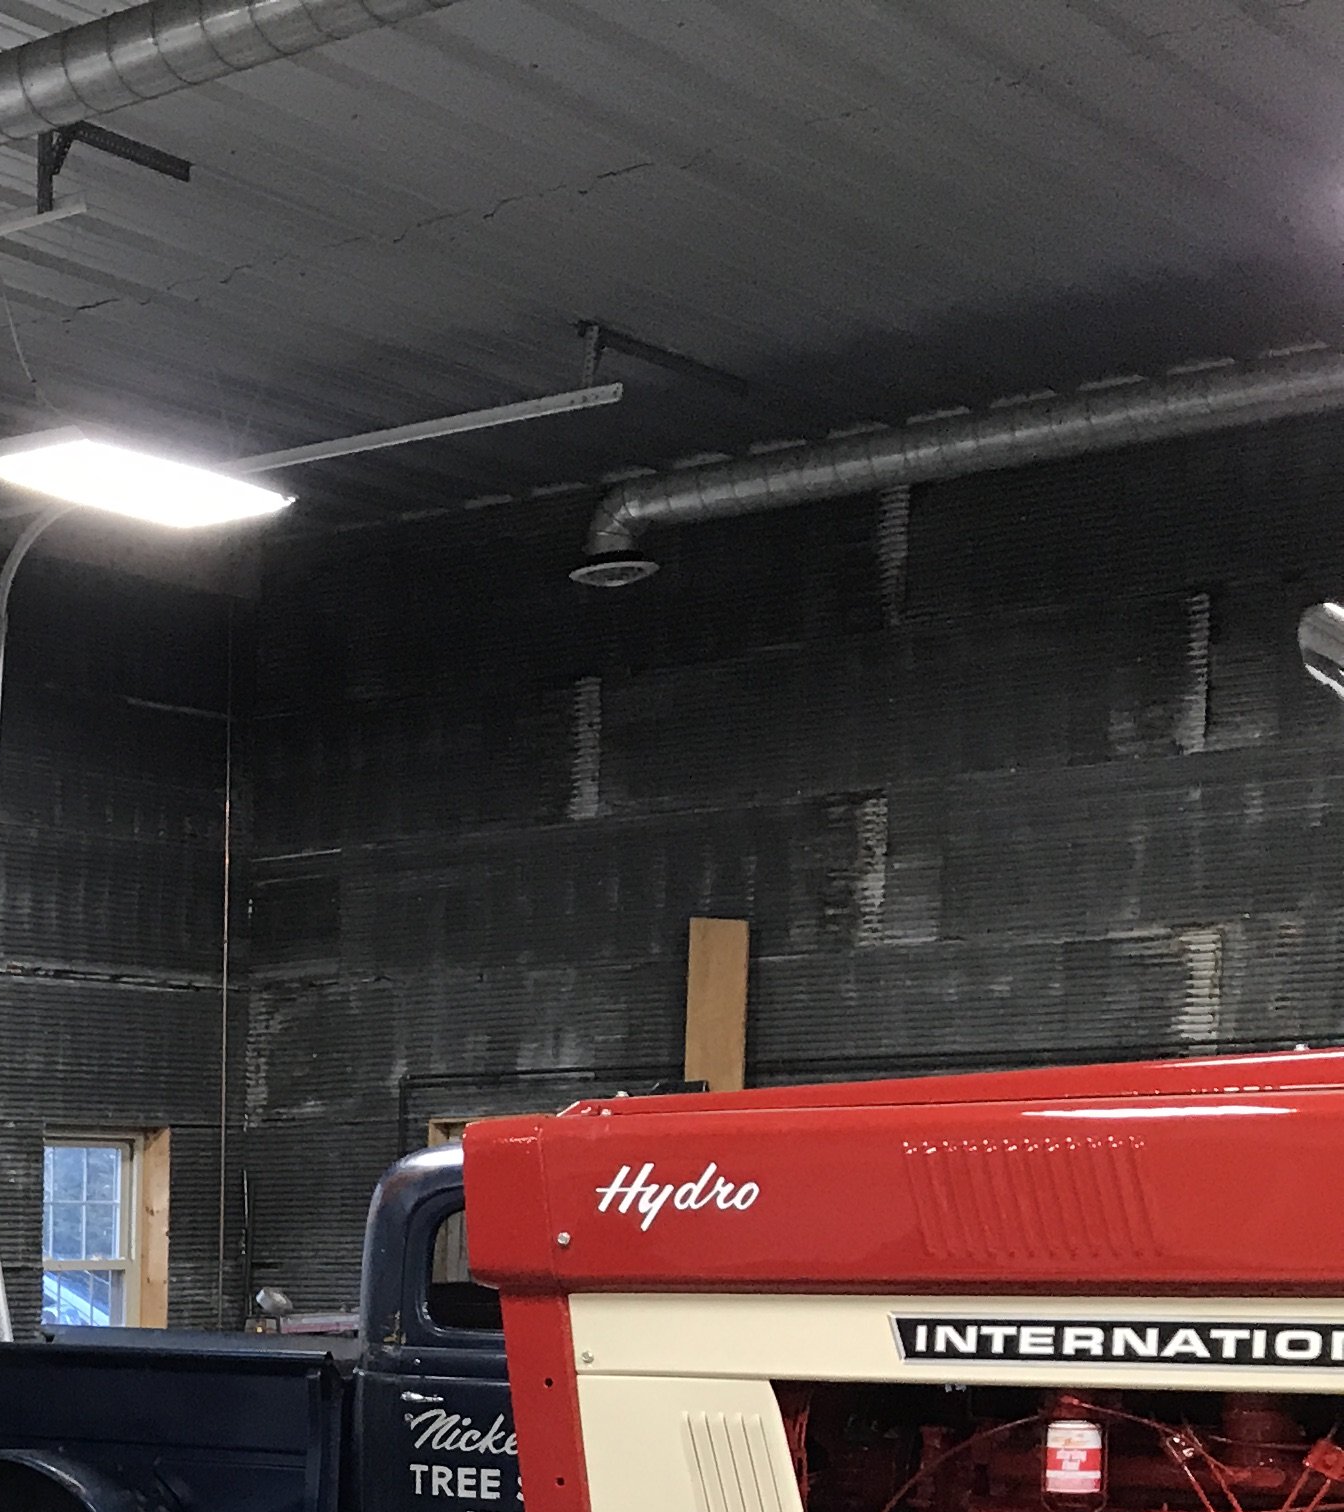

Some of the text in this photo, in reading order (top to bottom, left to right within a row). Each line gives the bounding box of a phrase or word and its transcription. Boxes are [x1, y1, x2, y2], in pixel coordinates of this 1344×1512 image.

[595, 1162, 760, 1232] Hydro
[914, 1324, 1344, 1361] INTERNATIO
[409, 1464, 501, 1500] TREE
